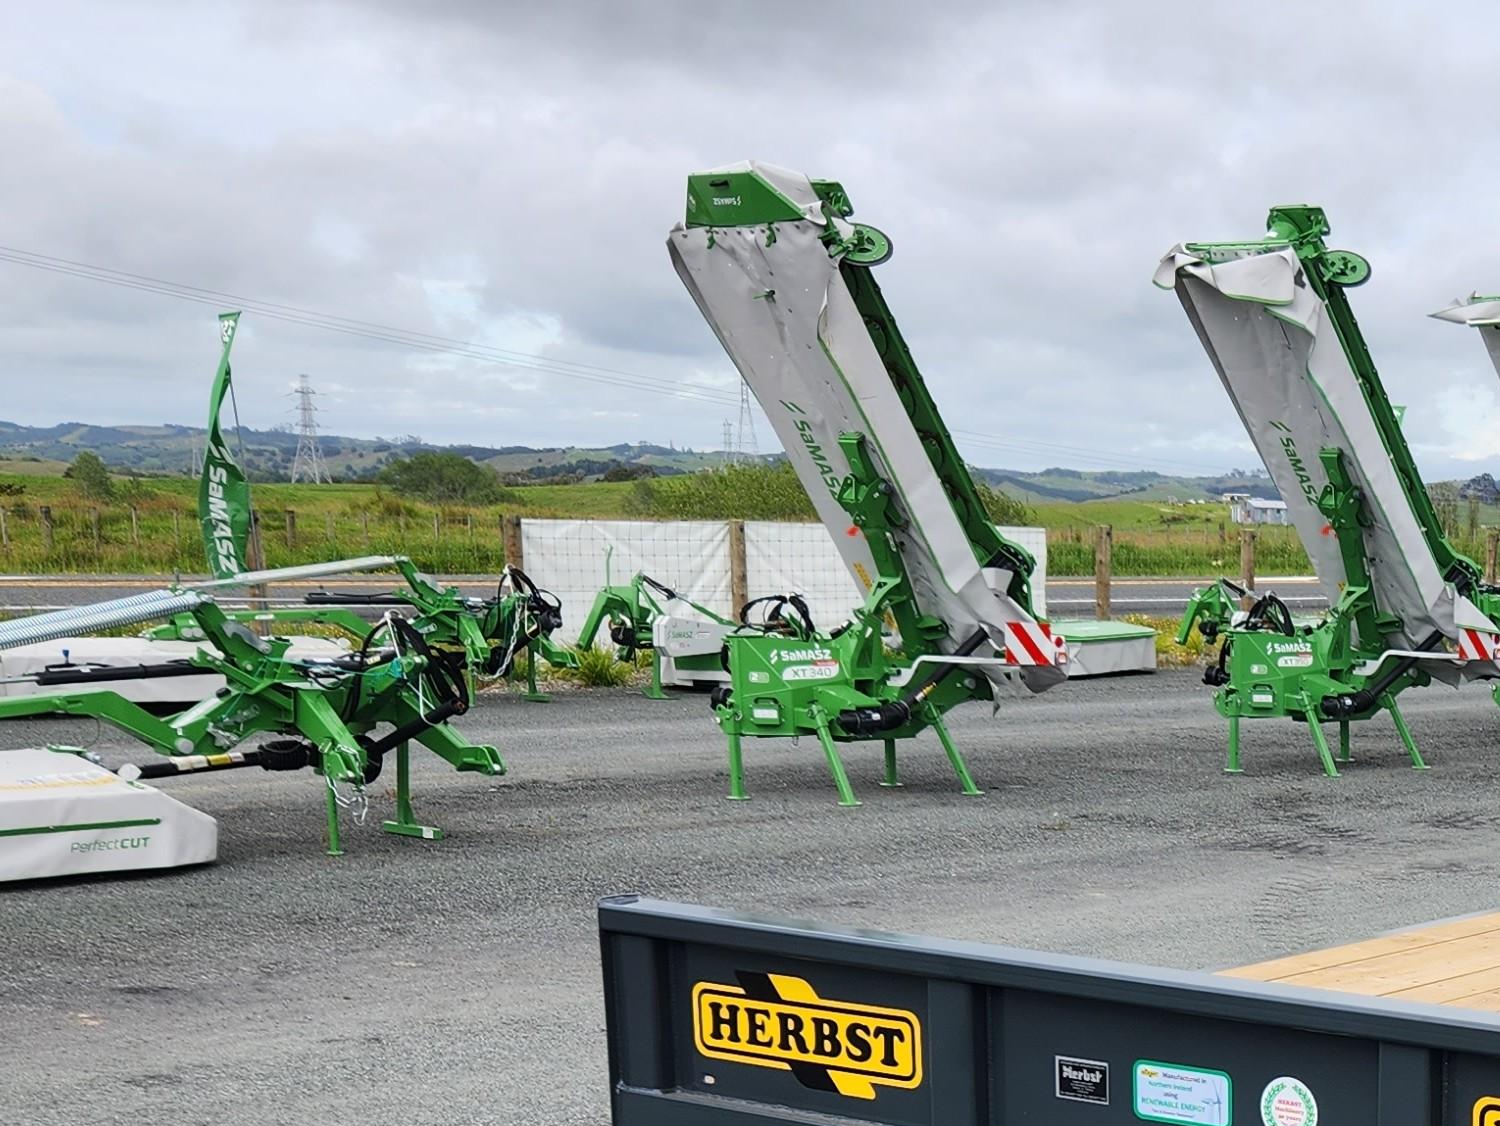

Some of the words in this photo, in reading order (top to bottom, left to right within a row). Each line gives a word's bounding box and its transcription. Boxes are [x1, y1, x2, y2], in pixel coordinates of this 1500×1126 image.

[1279, 436, 1321, 506] SaMASZ
[208, 465, 239, 575] SaMASZ
[780, 649, 832, 661] SaMASZ
[1274, 642, 1313, 653] SaMASZ
[791, 668, 808, 679] XT
[809, 667, 832, 678] 340
[708, 1001, 905, 1068] HERBST
